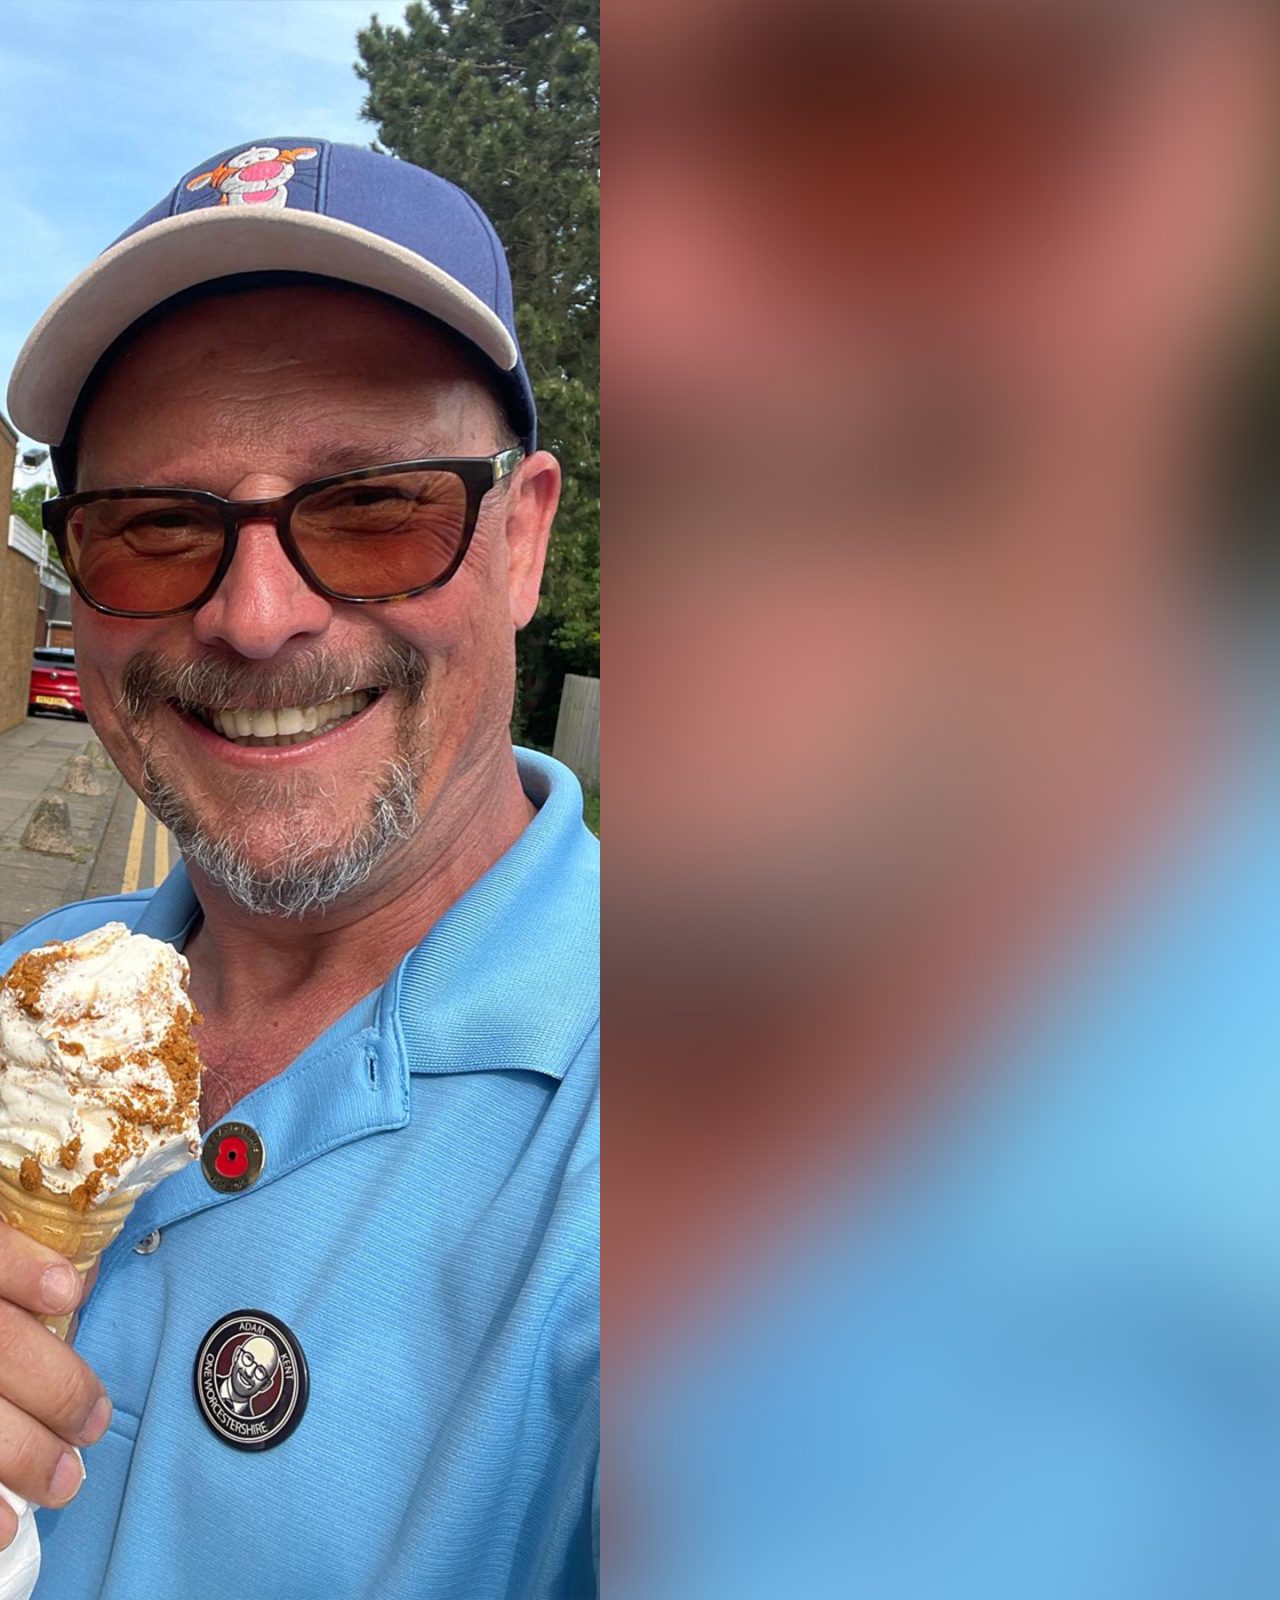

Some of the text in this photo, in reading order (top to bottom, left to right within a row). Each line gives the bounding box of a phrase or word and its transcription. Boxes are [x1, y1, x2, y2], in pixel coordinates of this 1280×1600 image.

[238, 1321, 294, 1381] ADAM KENT
[203, 1353, 268, 1436] ONE WORCESTERSHIRE
